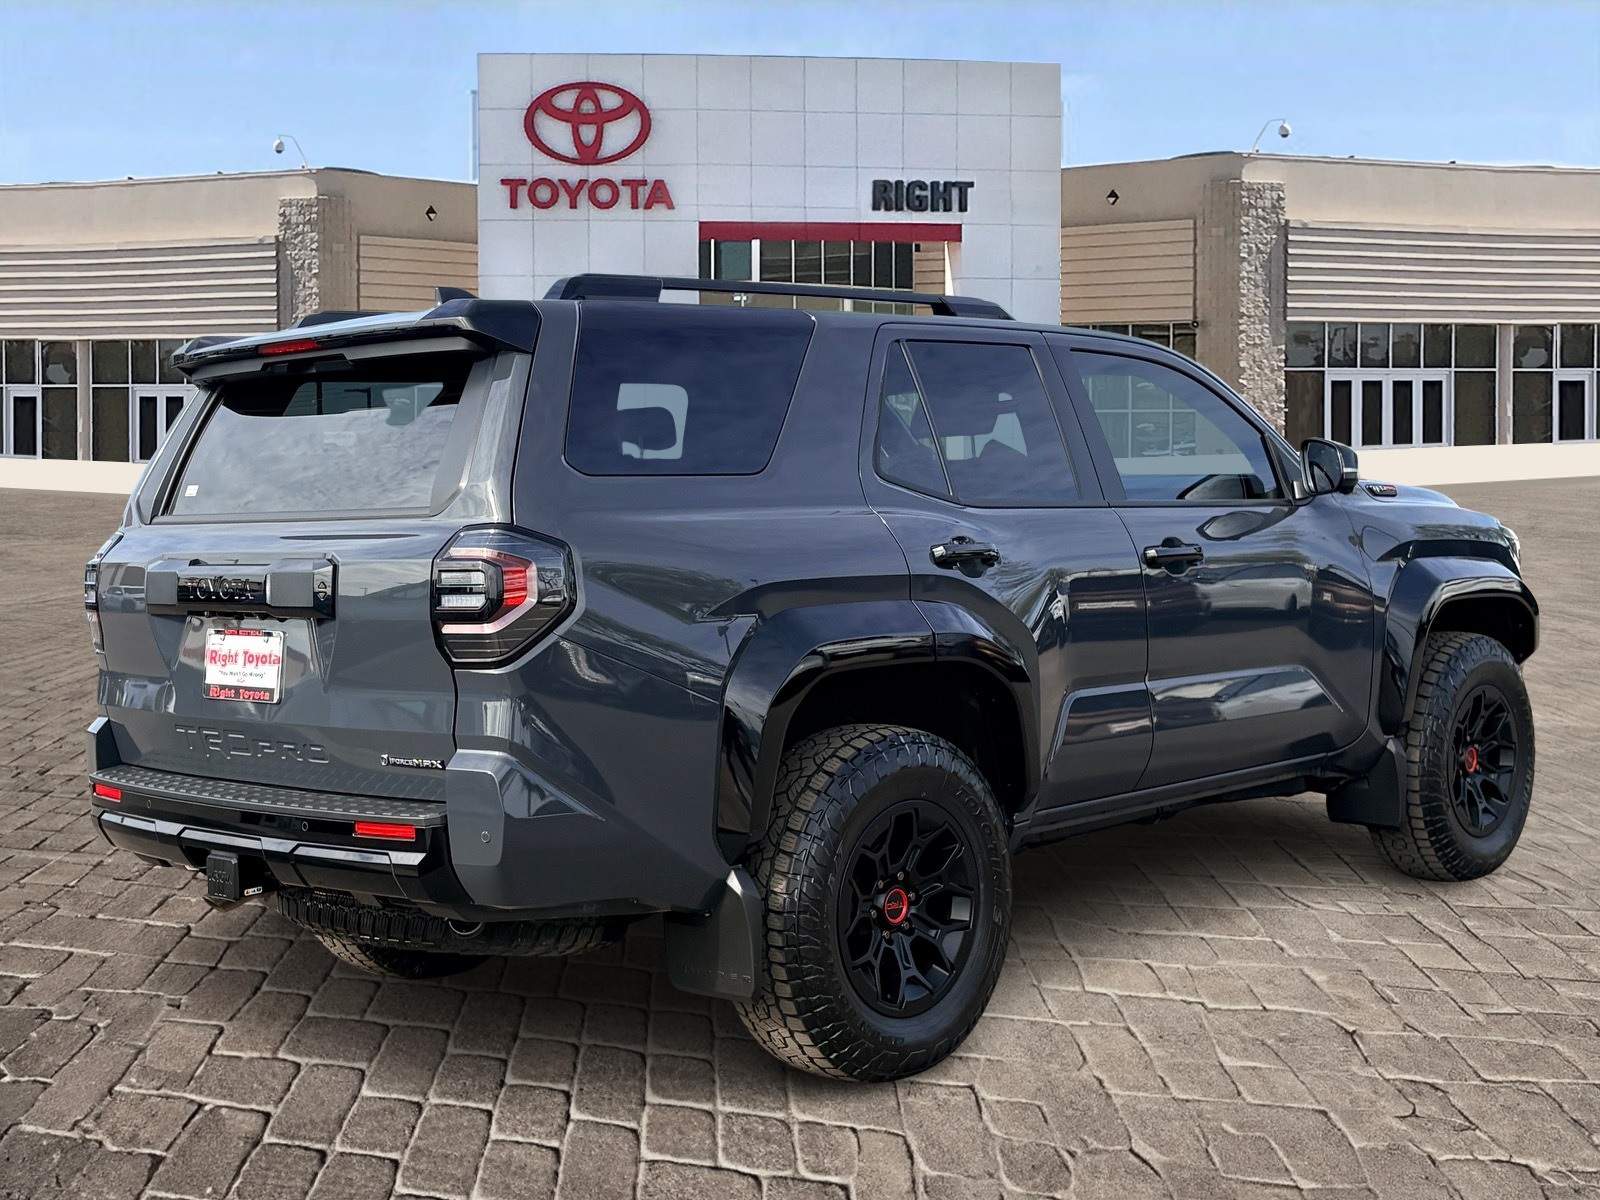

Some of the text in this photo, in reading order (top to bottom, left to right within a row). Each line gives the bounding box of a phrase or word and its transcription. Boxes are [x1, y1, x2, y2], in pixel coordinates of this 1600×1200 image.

[501, 178, 674, 210] TOYOTA
[872, 180, 974, 212] RIGHT
[209, 650, 280, 668] Right Toyota
[209, 685, 270, 700] Right Toyota
[175, 725, 330, 763] TRD PRO
